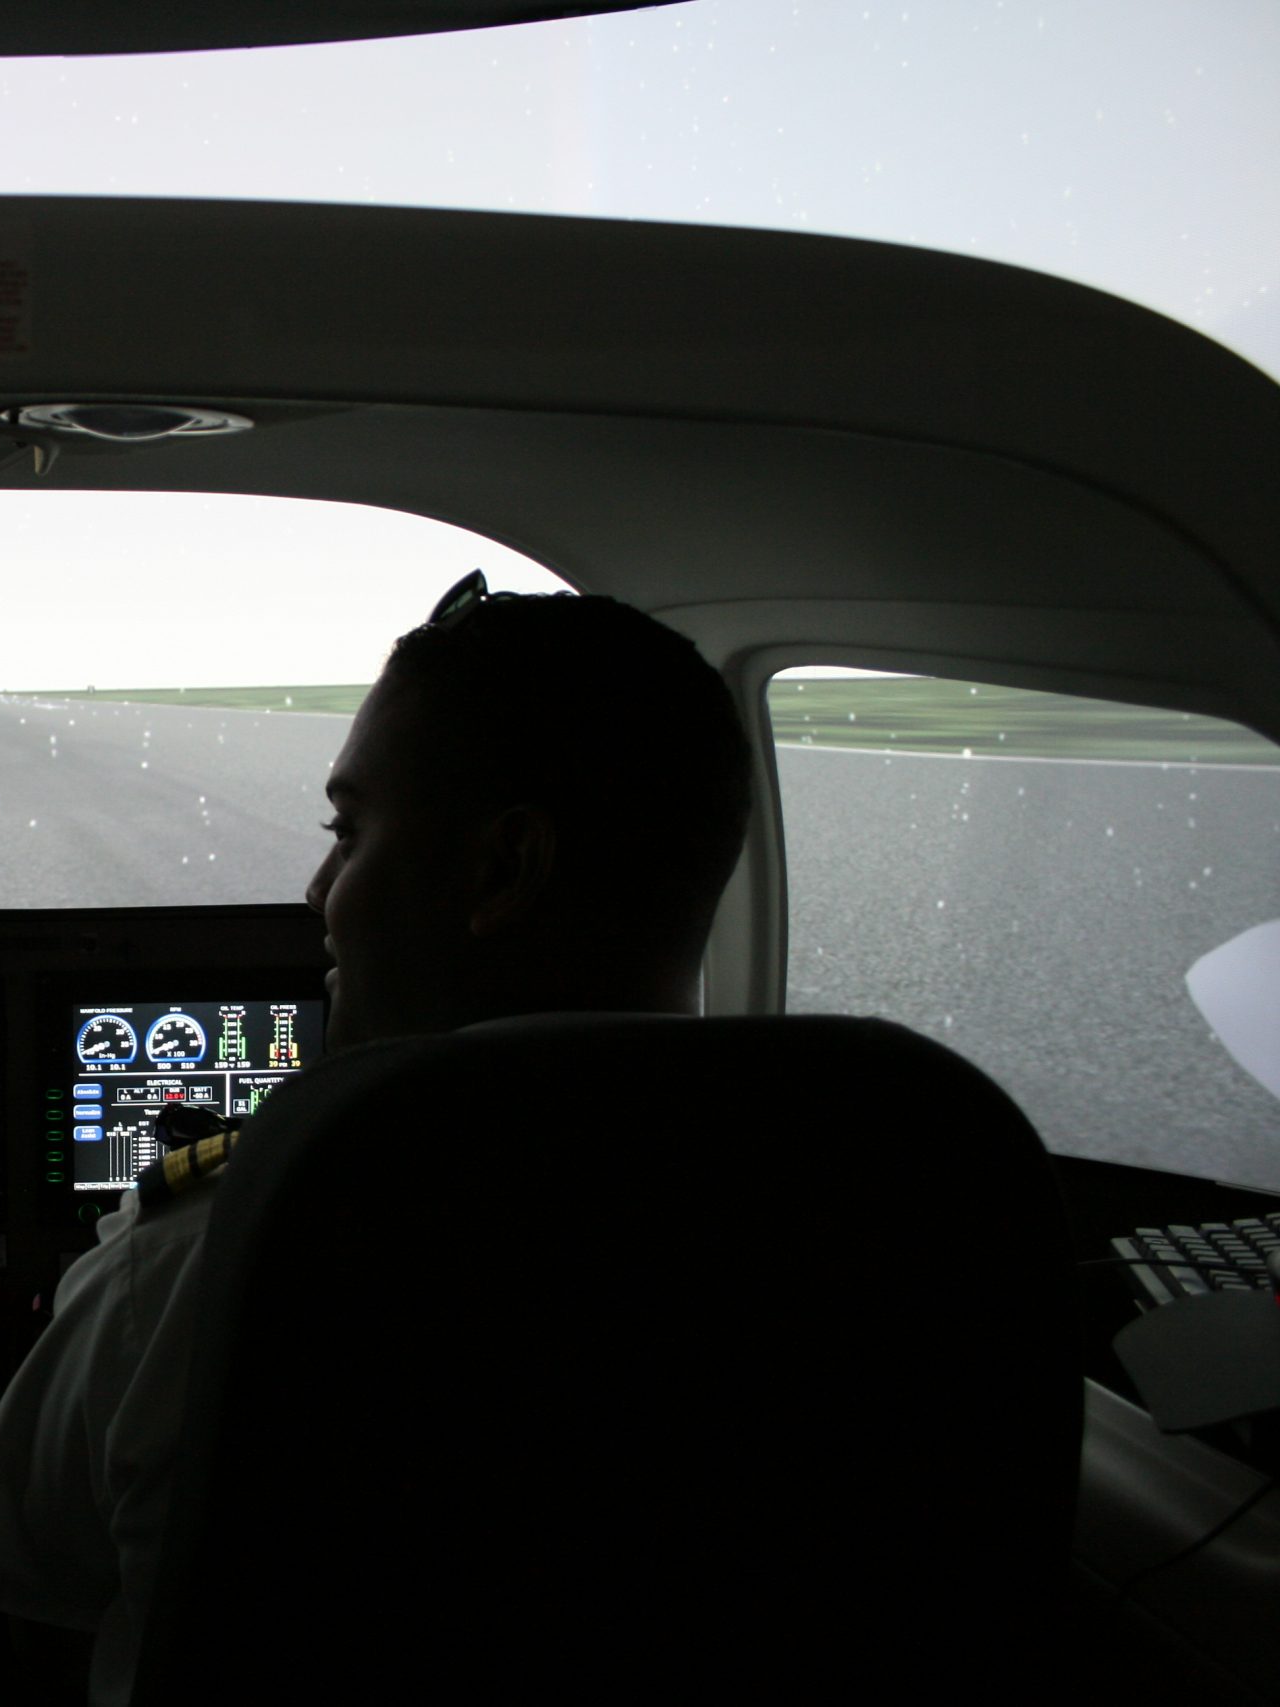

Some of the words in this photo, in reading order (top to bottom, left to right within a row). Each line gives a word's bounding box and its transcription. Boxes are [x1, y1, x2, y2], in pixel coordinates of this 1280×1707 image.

[110, 1063, 126, 1071] 10.1
[157, 1062, 171, 1070] 500
[254, 1077, 284, 1085] QUANTITY
